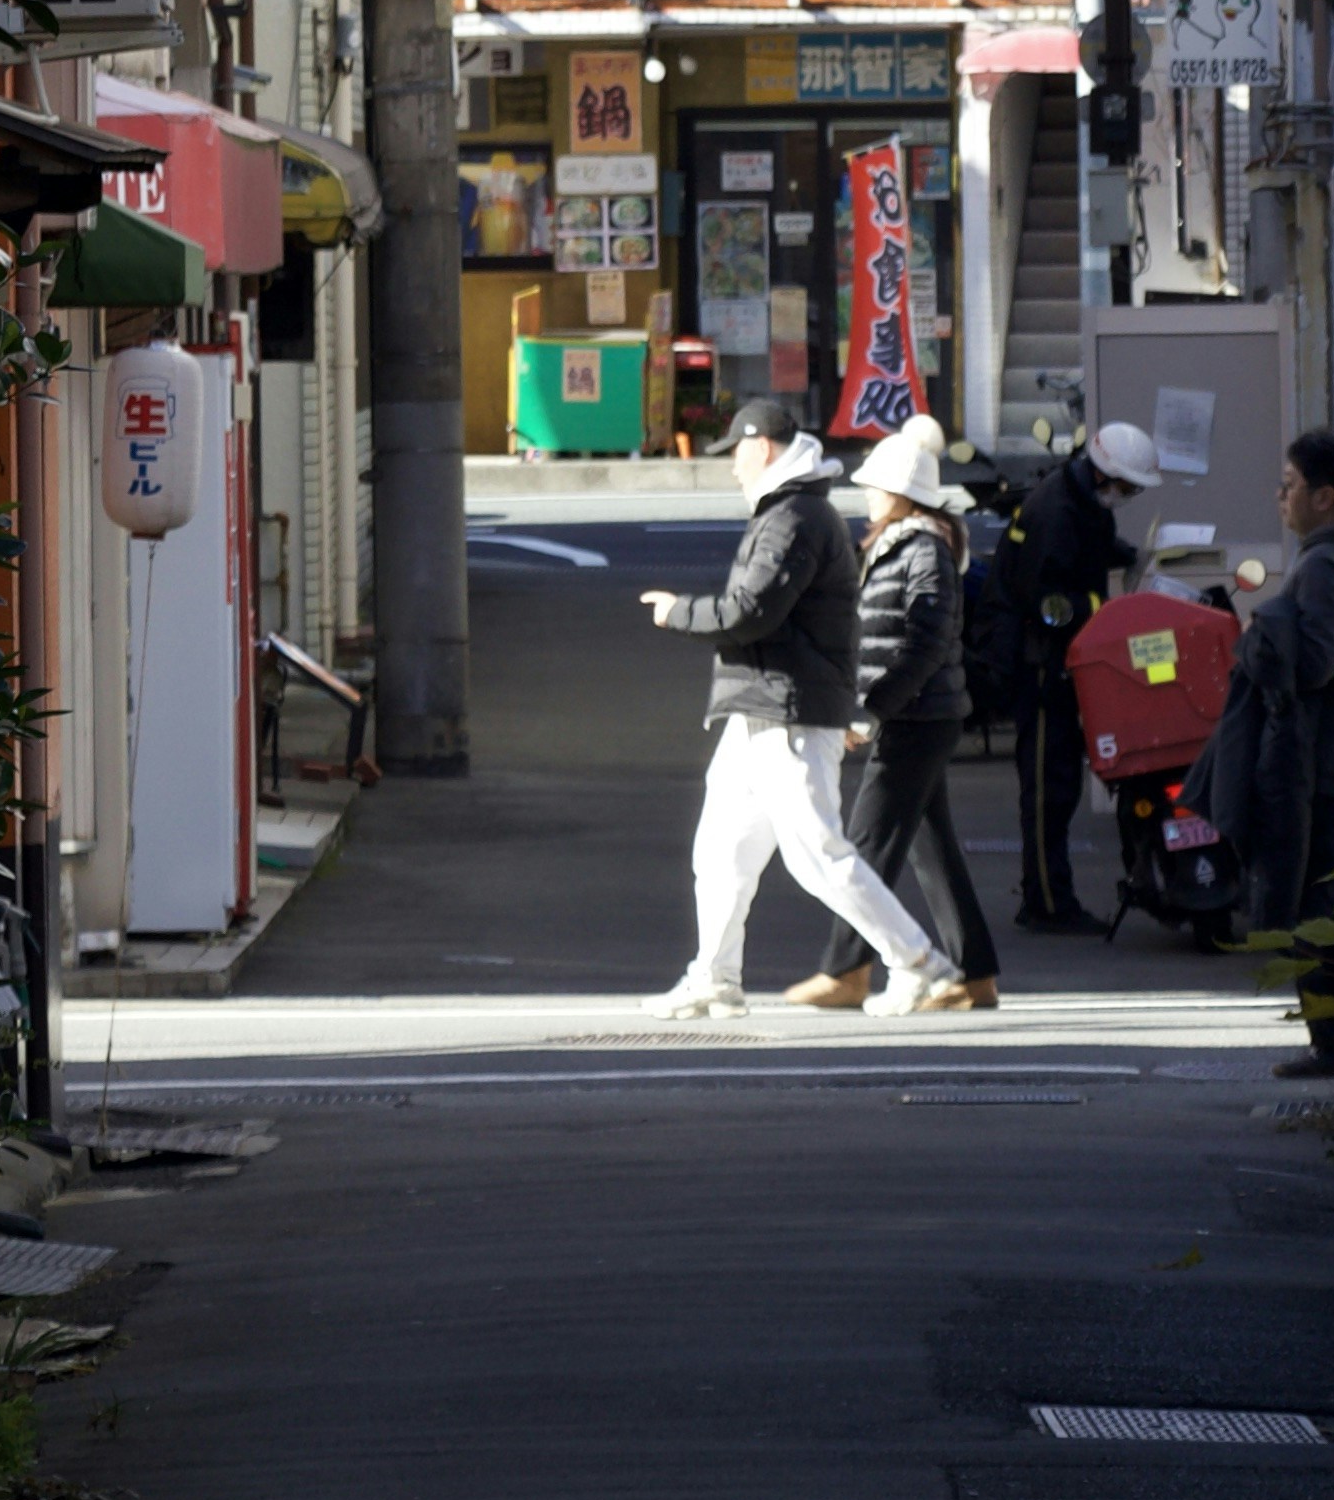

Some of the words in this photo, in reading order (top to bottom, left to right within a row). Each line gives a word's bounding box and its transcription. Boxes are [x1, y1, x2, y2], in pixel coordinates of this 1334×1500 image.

[799, 43, 948, 92] 那智家
[1171, 57, 1267, 83] 0557-81-8728
[578, 83, 631, 140] 鍋
[854, 168, 914, 433] お食事処
[124, 395, 167, 496] 生ビール
[1096, 735, 1117, 759] 5
